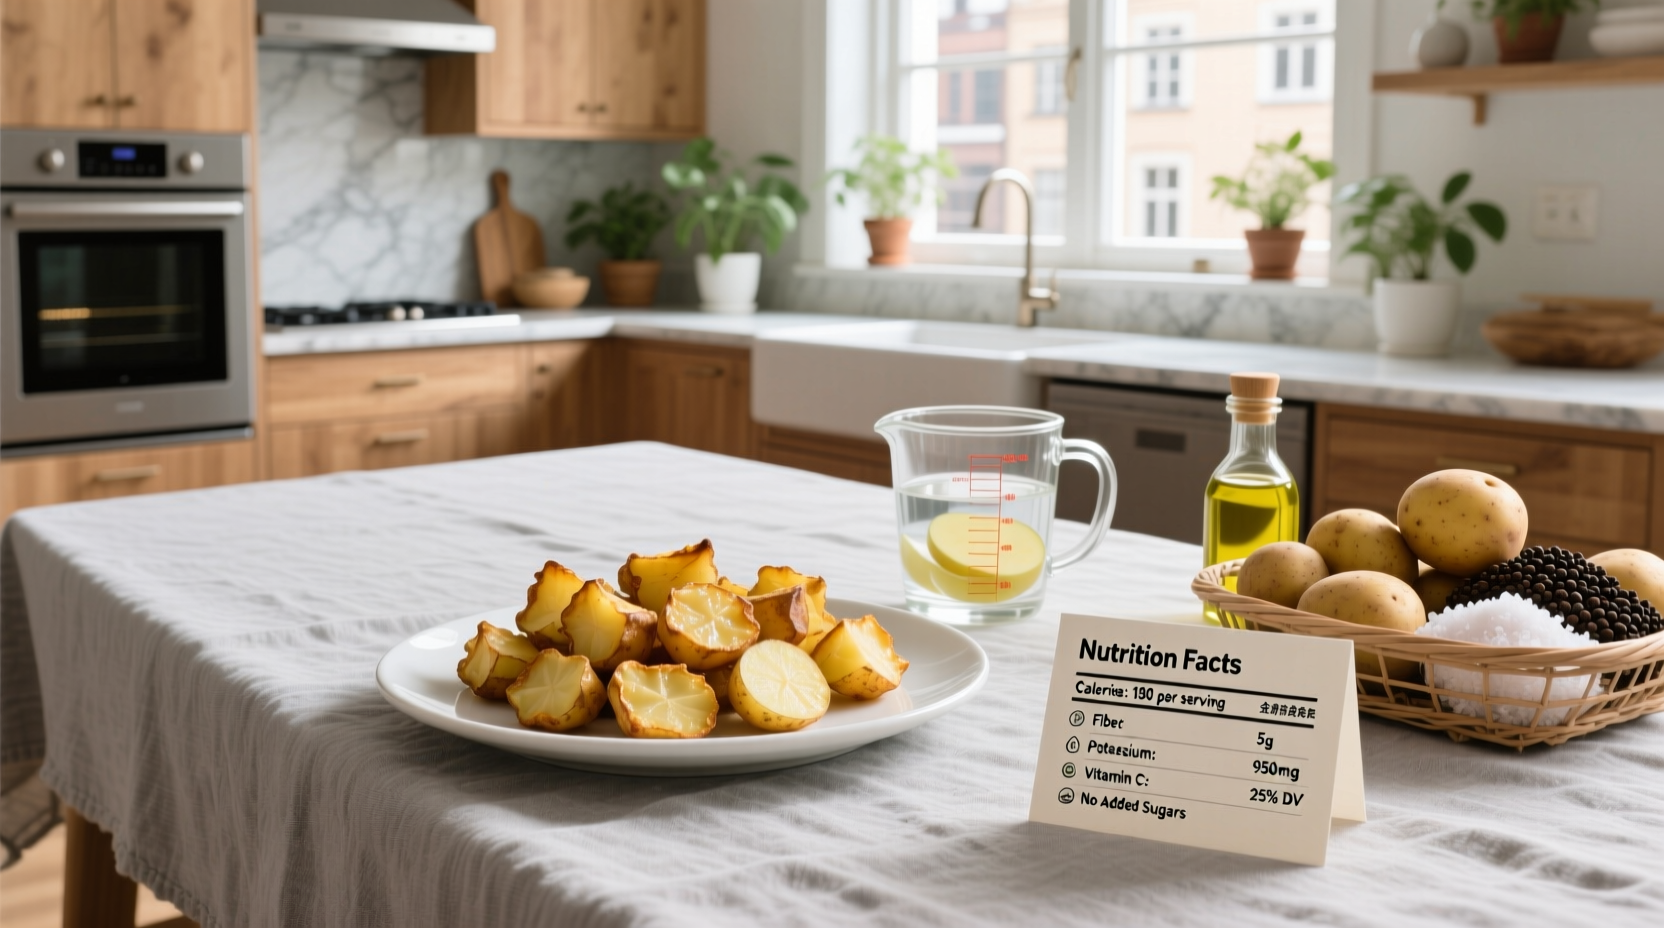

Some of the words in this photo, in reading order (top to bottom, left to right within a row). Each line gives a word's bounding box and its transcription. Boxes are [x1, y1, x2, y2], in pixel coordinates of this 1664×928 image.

[1079, 638, 1177, 668] Nutrition
[1183, 649, 1241, 675] Facts
[1157, 693, 1177, 705] per
[1180, 695, 1225, 712] serving
[1257, 732, 1273, 750] 5g
[1085, 766, 1131, 784] Vitamin
[1136, 773, 1149, 786] C:
[1253, 760, 1299, 782] 950mg
[1081, 792, 1097, 805] No
[1100, 796, 1139, 812] Added
[1142, 801, 1186, 819] Sugars
[1250, 788, 1278, 804] 25%
[1282, 792, 1304, 806] DV
